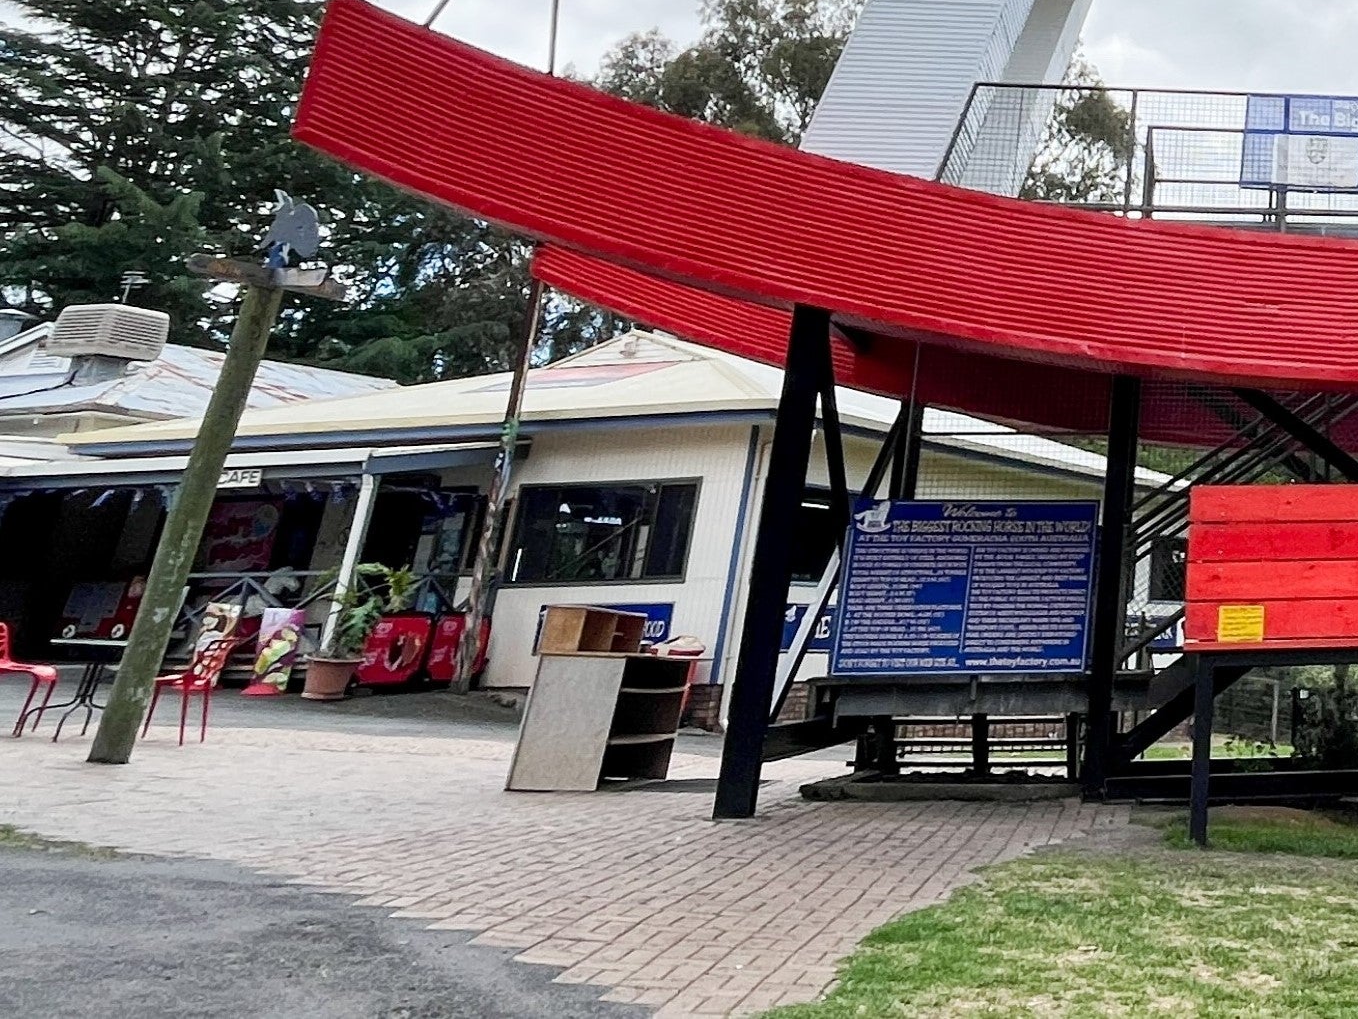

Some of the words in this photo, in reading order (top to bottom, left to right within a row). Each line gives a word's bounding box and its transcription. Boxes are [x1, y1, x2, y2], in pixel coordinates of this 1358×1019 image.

[1299, 110, 1330, 127] The
[942, 503, 1002, 518] Welcome
[1004, 507, 1018, 517] to
[893, 520, 910, 533] THE
[911, 520, 950, 533] BIGGEST
[951, 520, 992, 533] ROCKING
[993, 520, 1024, 533] HORSE
[1025, 520, 1035, 533] IN
[1036, 520, 1053, 533] THE
[858, 535, 869, 543] AT
[891, 535, 909, 543] TOY
[911, 534, 950, 542] FACTORY
[1040, 534, 1089, 542] AUSTRALIA
[965, 655, 1081, 669] www.thetoyfactory.com.au
